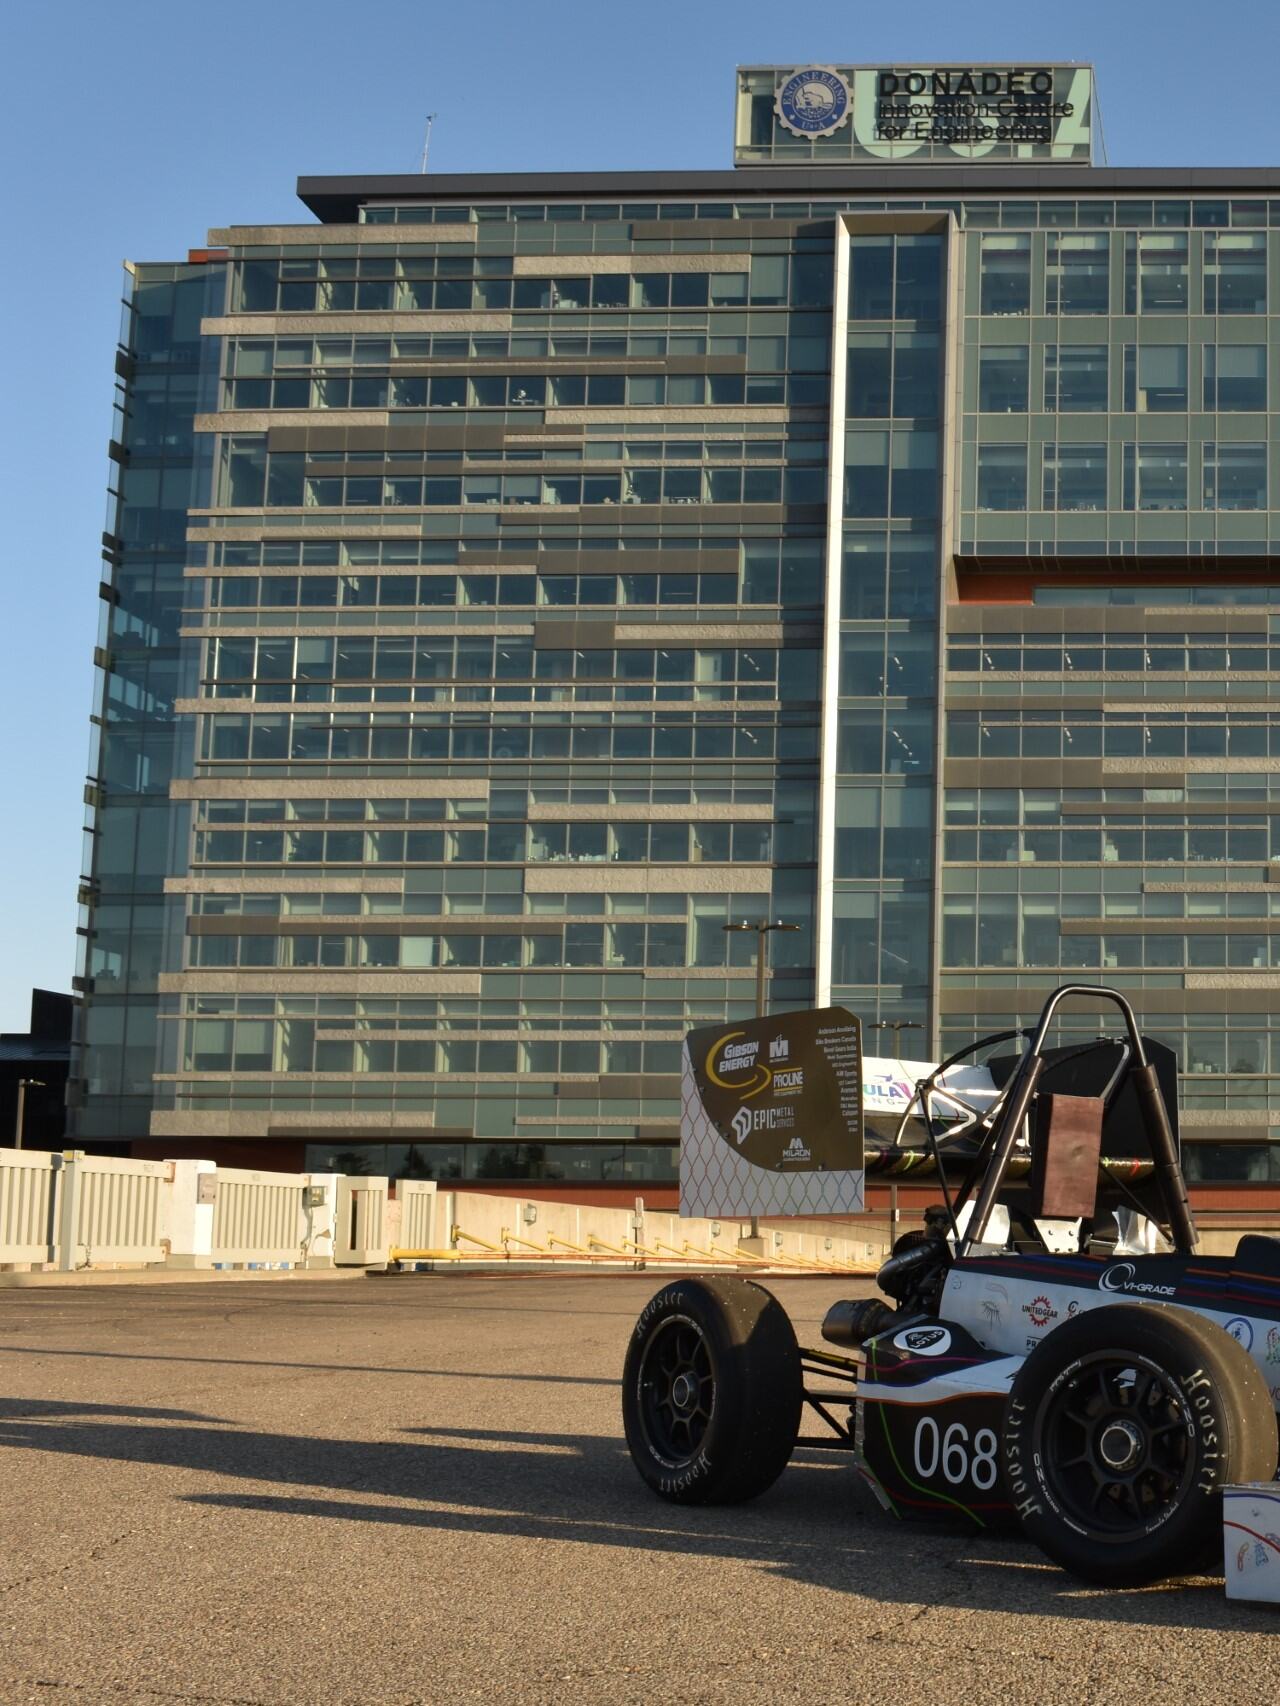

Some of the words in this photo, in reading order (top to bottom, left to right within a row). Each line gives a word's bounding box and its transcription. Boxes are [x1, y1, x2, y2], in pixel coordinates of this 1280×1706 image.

[782, 71, 847, 105] ENGINEERING
[879, 71, 1053, 97] DONADEO
[878, 99, 990, 118] Innovation
[997, 98, 1075, 118] Centre
[875, 121, 905, 141] for
[914, 121, 1053, 145] Engineering
[724, 1041, 760, 1059] GIBSON
[719, 1054, 756, 1073] ENERGY
[773, 1071, 804, 1089] PROLINE
[753, 1107, 777, 1131] EPIC
[776, 1106, 795, 1118] METAL
[1123, 1281, 1177, 1296] VI-GRADE
[635, 1291, 684, 1338] Hoosier
[1022, 1304, 1059, 1319] UNITEDGEAR
[909, 1330, 944, 1349] LOTUS
[1180, 1368, 1228, 1495] Hoosier
[914, 1416, 998, 1491] 068
[1003, 1397, 1043, 1520] Hoosier
[659, 1448, 713, 1493] Hoosier
